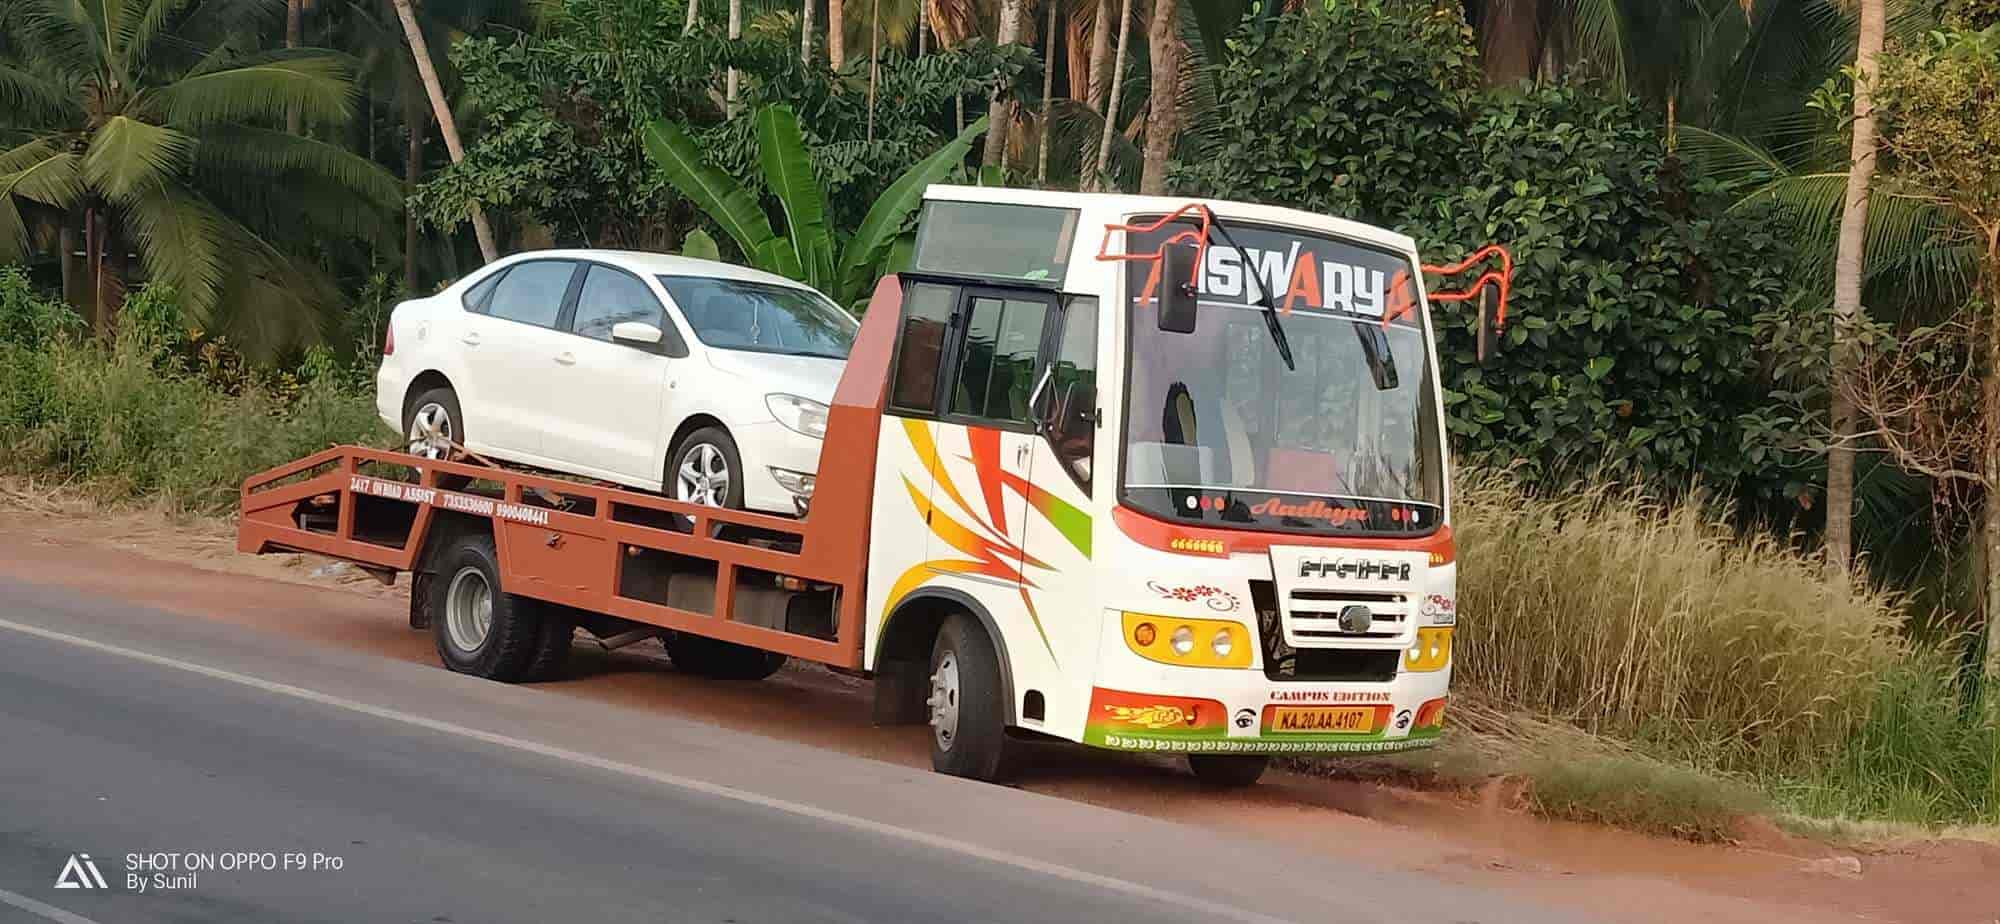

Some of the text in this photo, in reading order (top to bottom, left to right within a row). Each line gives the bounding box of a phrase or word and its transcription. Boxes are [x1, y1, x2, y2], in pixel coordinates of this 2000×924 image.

[404, 486, 436, 505] ASSIST
[1298, 556, 1411, 581] EICHER
[1270, 690, 1391, 702] CAMPUS EDITION
